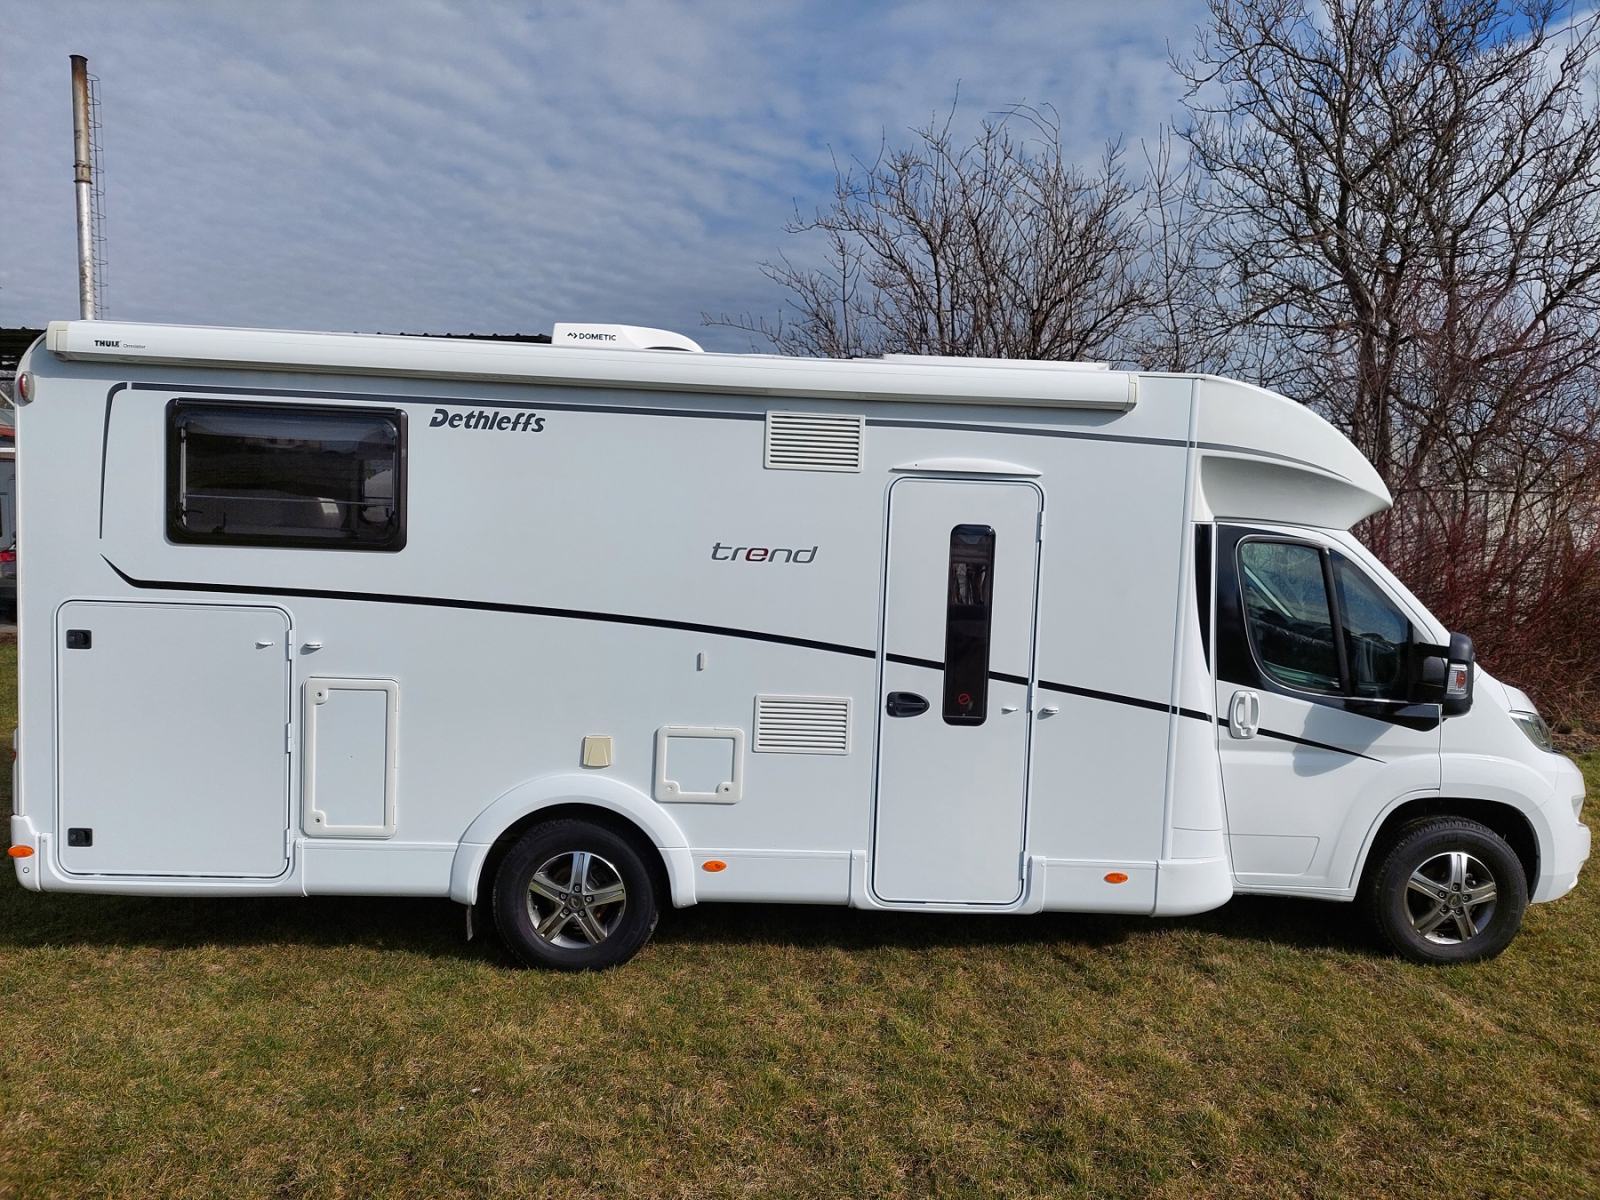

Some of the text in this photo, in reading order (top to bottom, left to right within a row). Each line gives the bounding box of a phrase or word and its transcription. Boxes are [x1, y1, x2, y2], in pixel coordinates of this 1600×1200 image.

[94, 339, 120, 348] THULE
[579, 332, 617, 341] DOMETIC
[429, 408, 546, 433] Dethleffs
[711, 542, 819, 564] trend
